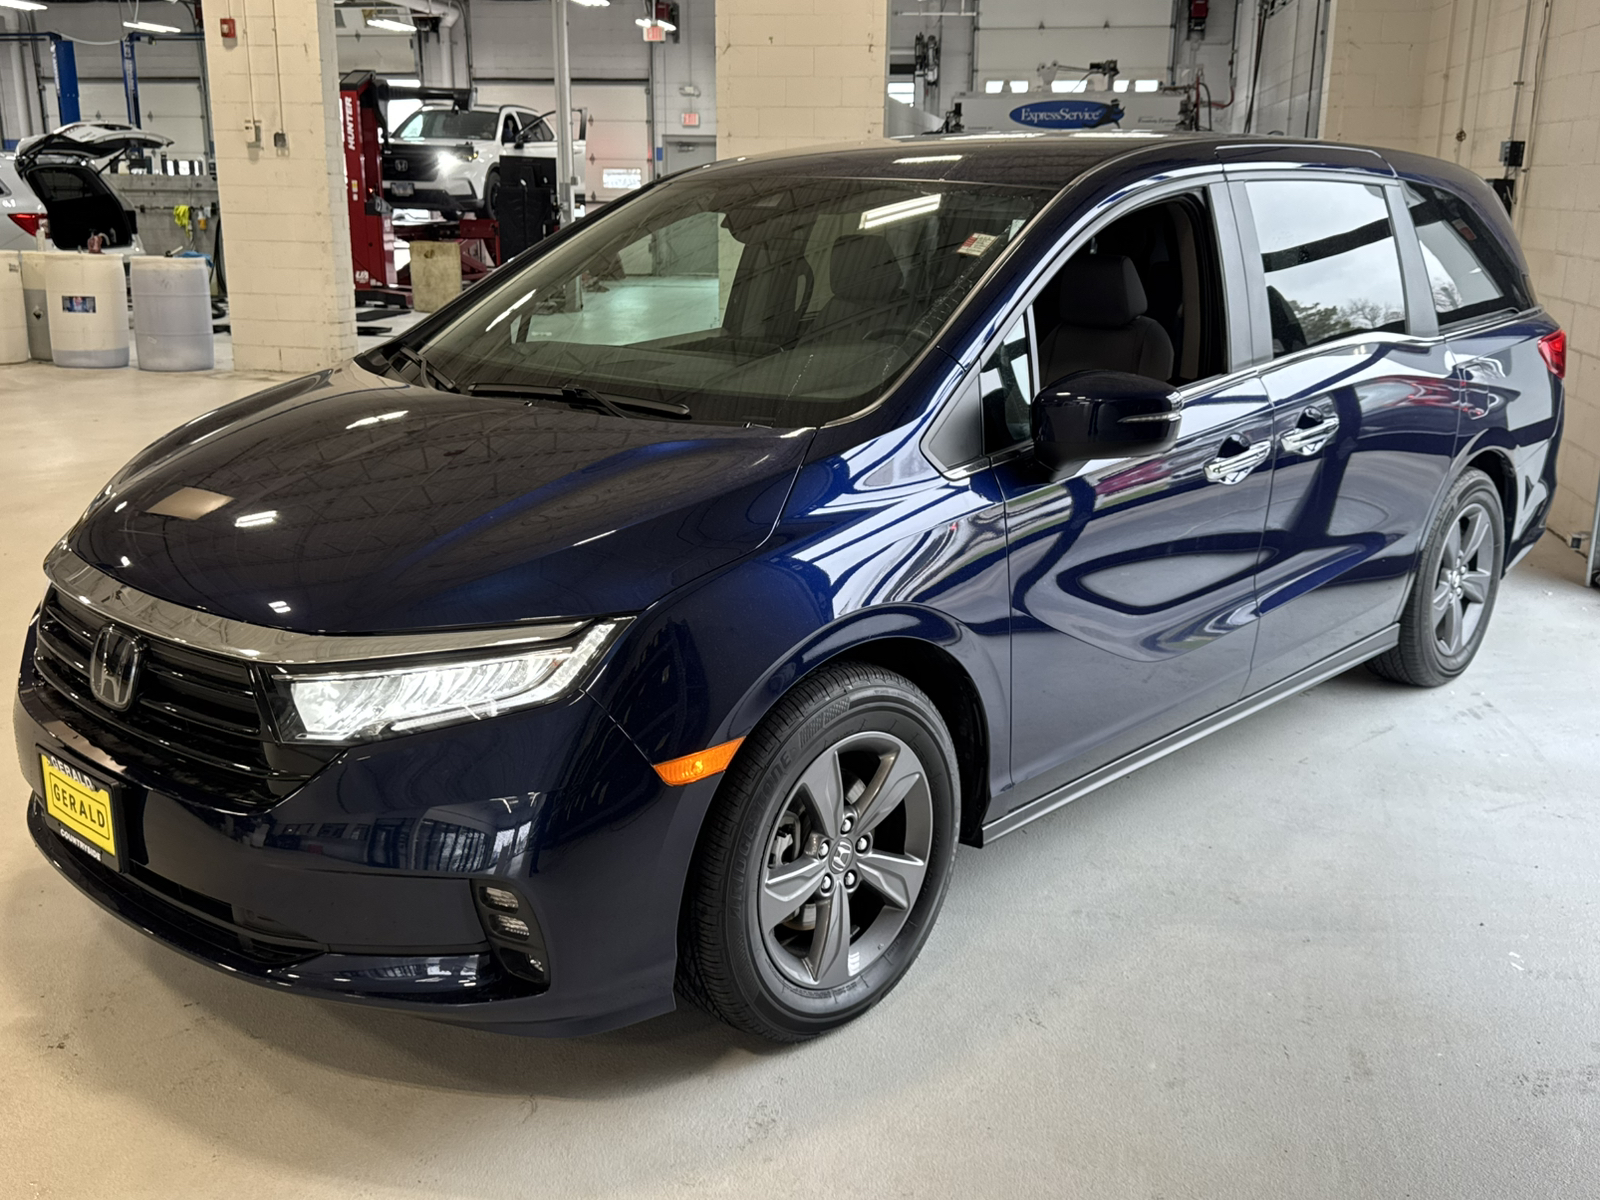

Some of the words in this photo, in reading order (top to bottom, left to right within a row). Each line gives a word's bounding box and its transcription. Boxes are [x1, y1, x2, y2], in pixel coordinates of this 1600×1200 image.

[344, 96, 356, 151] HUNTER
[1020, 107, 1100, 124] ExpressService
[50, 755, 93, 789] GERALD
[53, 783, 105, 828] GERALD
